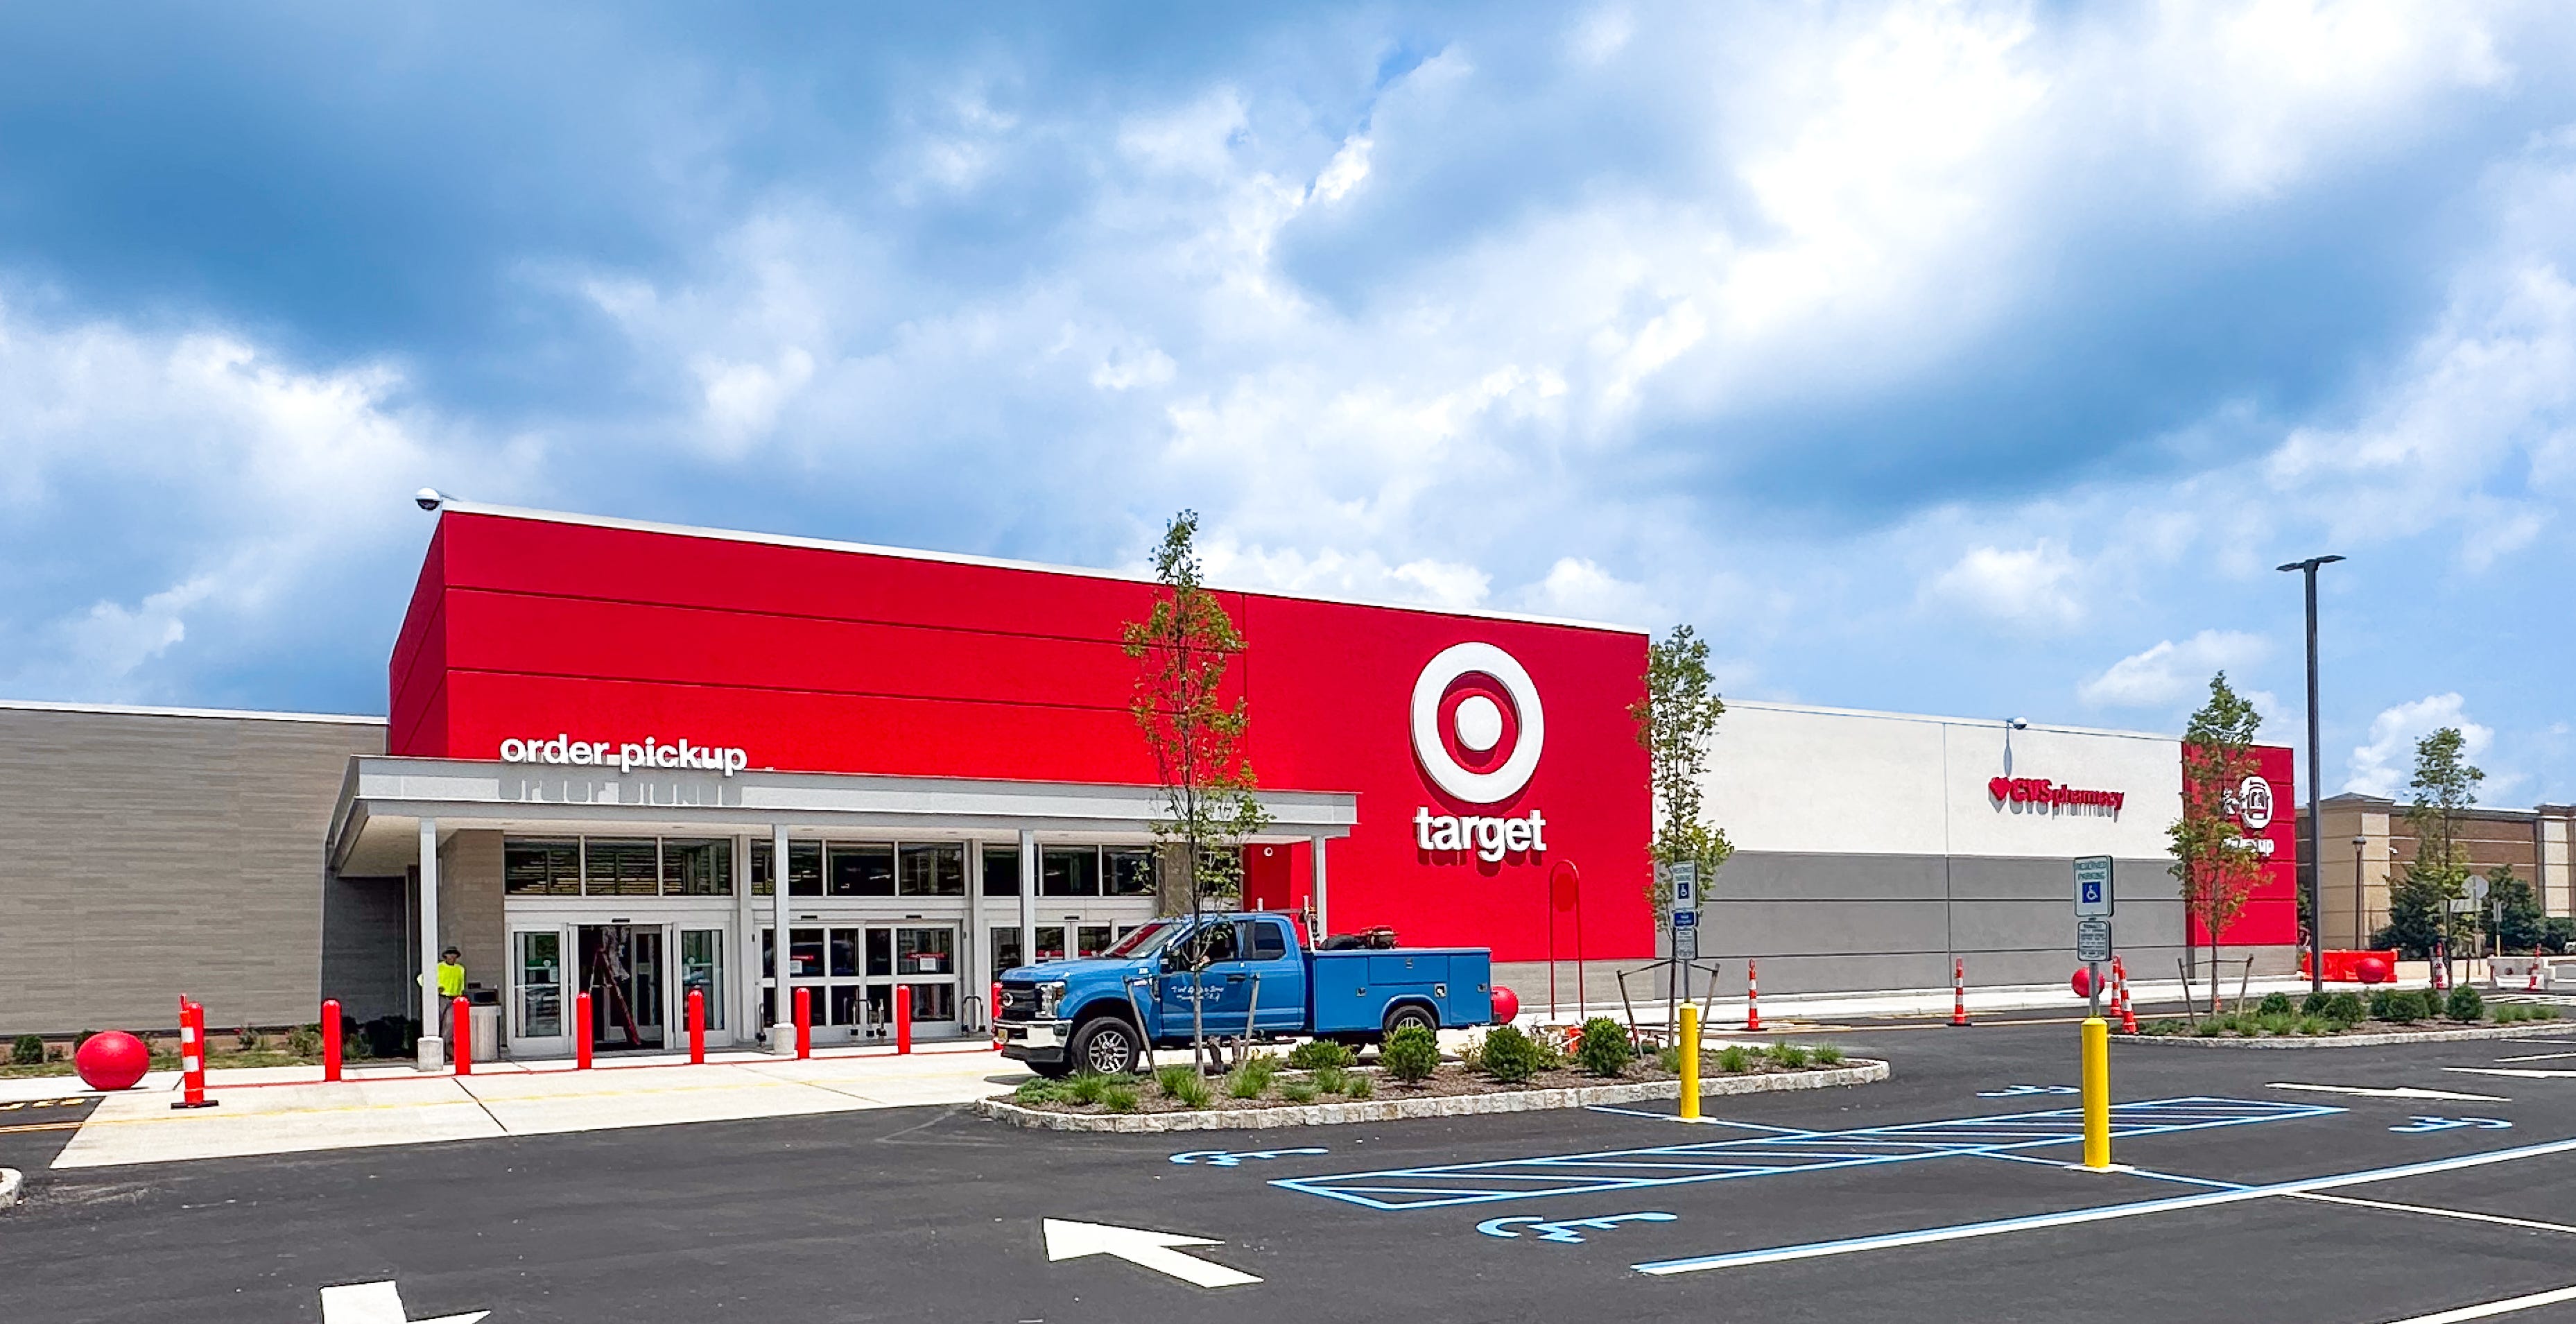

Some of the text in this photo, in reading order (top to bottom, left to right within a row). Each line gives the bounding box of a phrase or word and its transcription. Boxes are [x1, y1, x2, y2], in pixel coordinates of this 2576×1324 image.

[500, 733, 747, 776] order pickup
[2009, 777, 2125, 811] CVS pharmacy
[1412, 807, 1548, 862] target
